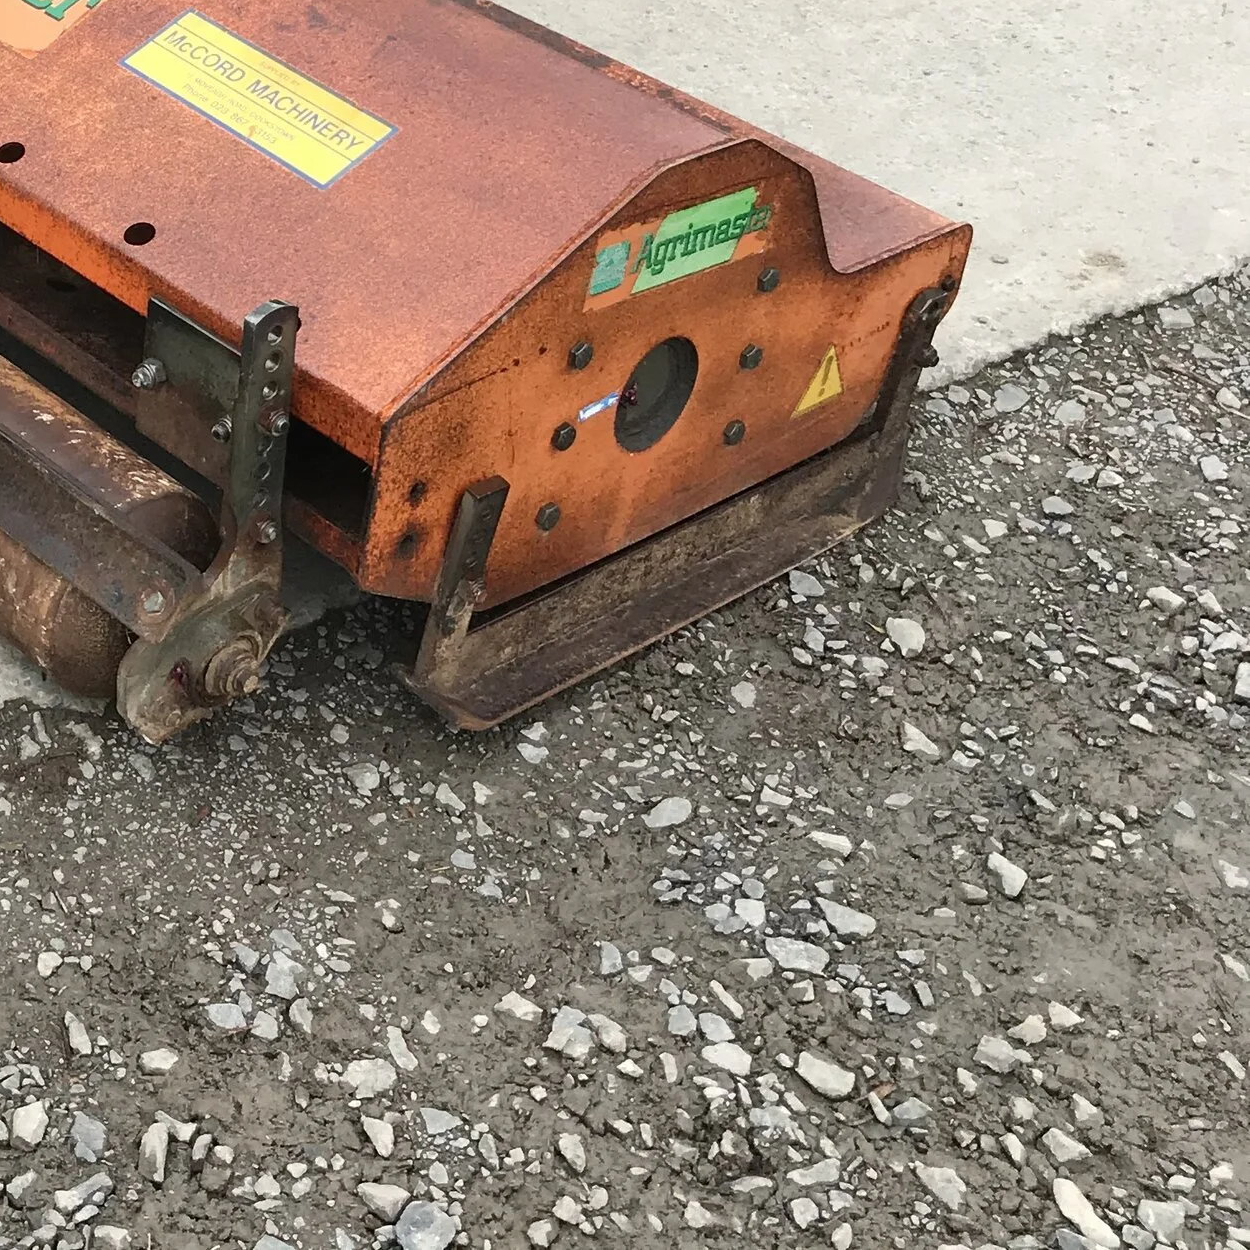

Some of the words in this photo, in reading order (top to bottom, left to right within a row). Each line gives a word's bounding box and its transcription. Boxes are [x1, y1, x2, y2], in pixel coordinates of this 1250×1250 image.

[163, 30, 247, 83] McCORD
[245, 78, 365, 152] MACHINERY
[181, 83, 210, 103] Phone
